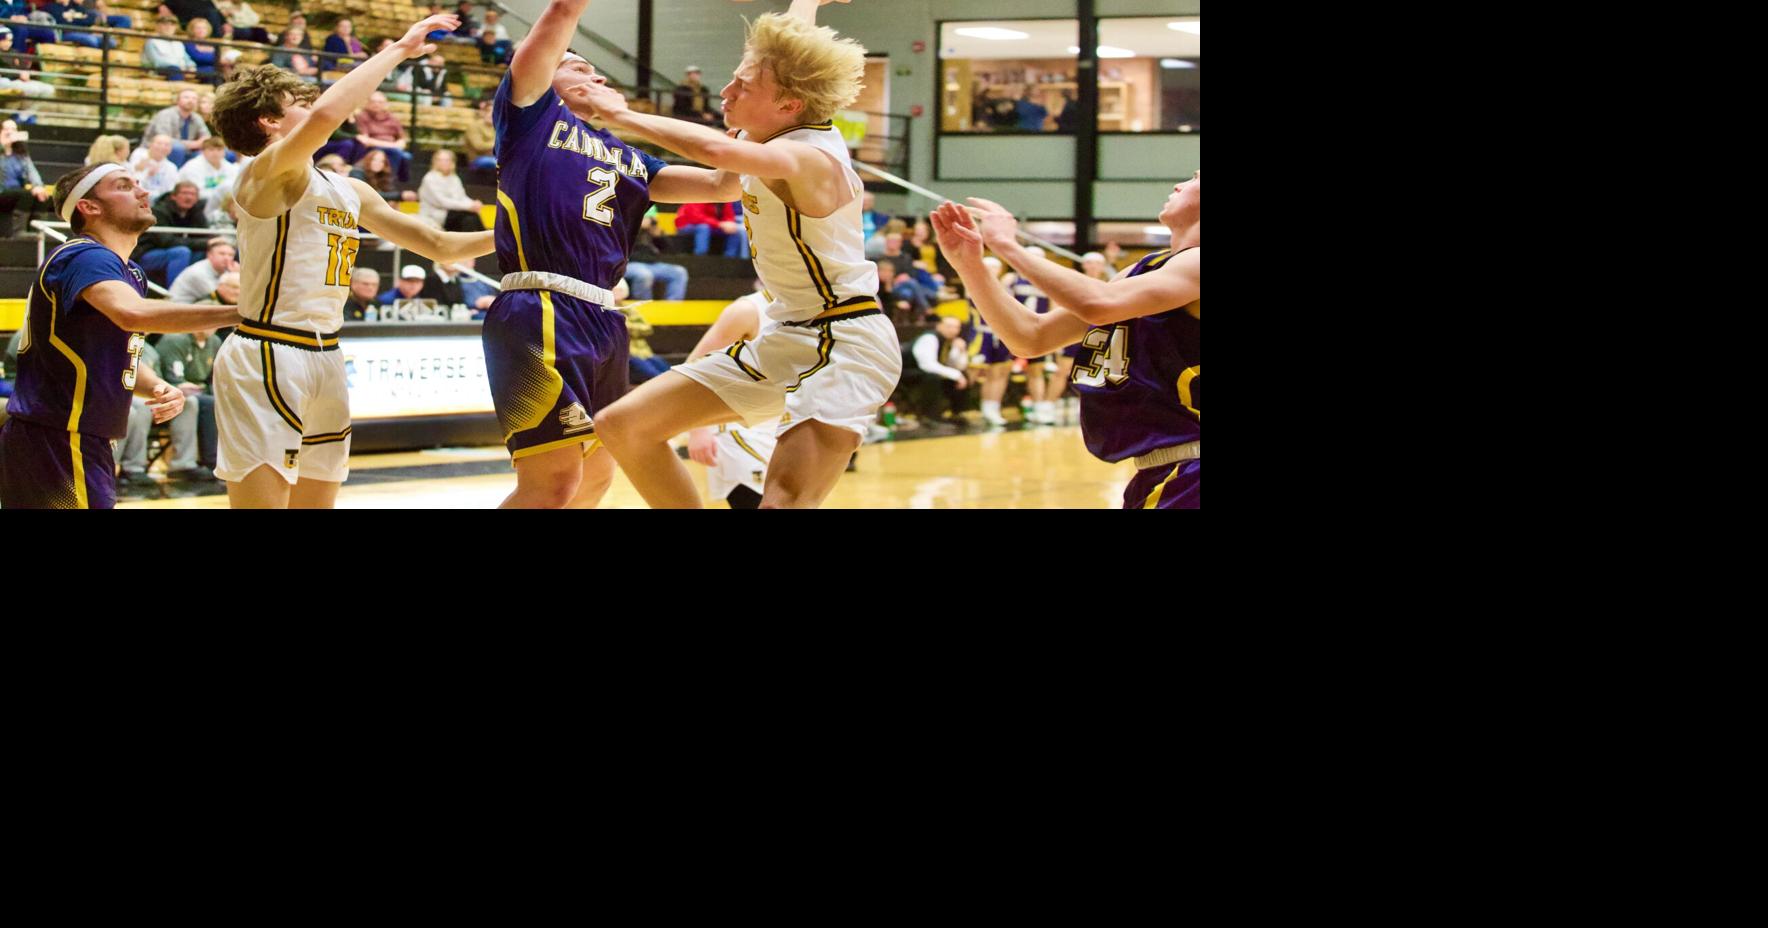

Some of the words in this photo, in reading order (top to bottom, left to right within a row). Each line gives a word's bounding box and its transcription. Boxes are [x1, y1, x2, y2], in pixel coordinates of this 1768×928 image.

[582, 166, 620, 227] 2
[366, 356, 466, 381] TRAVERSE
[1071, 325, 1130, 388] 34
